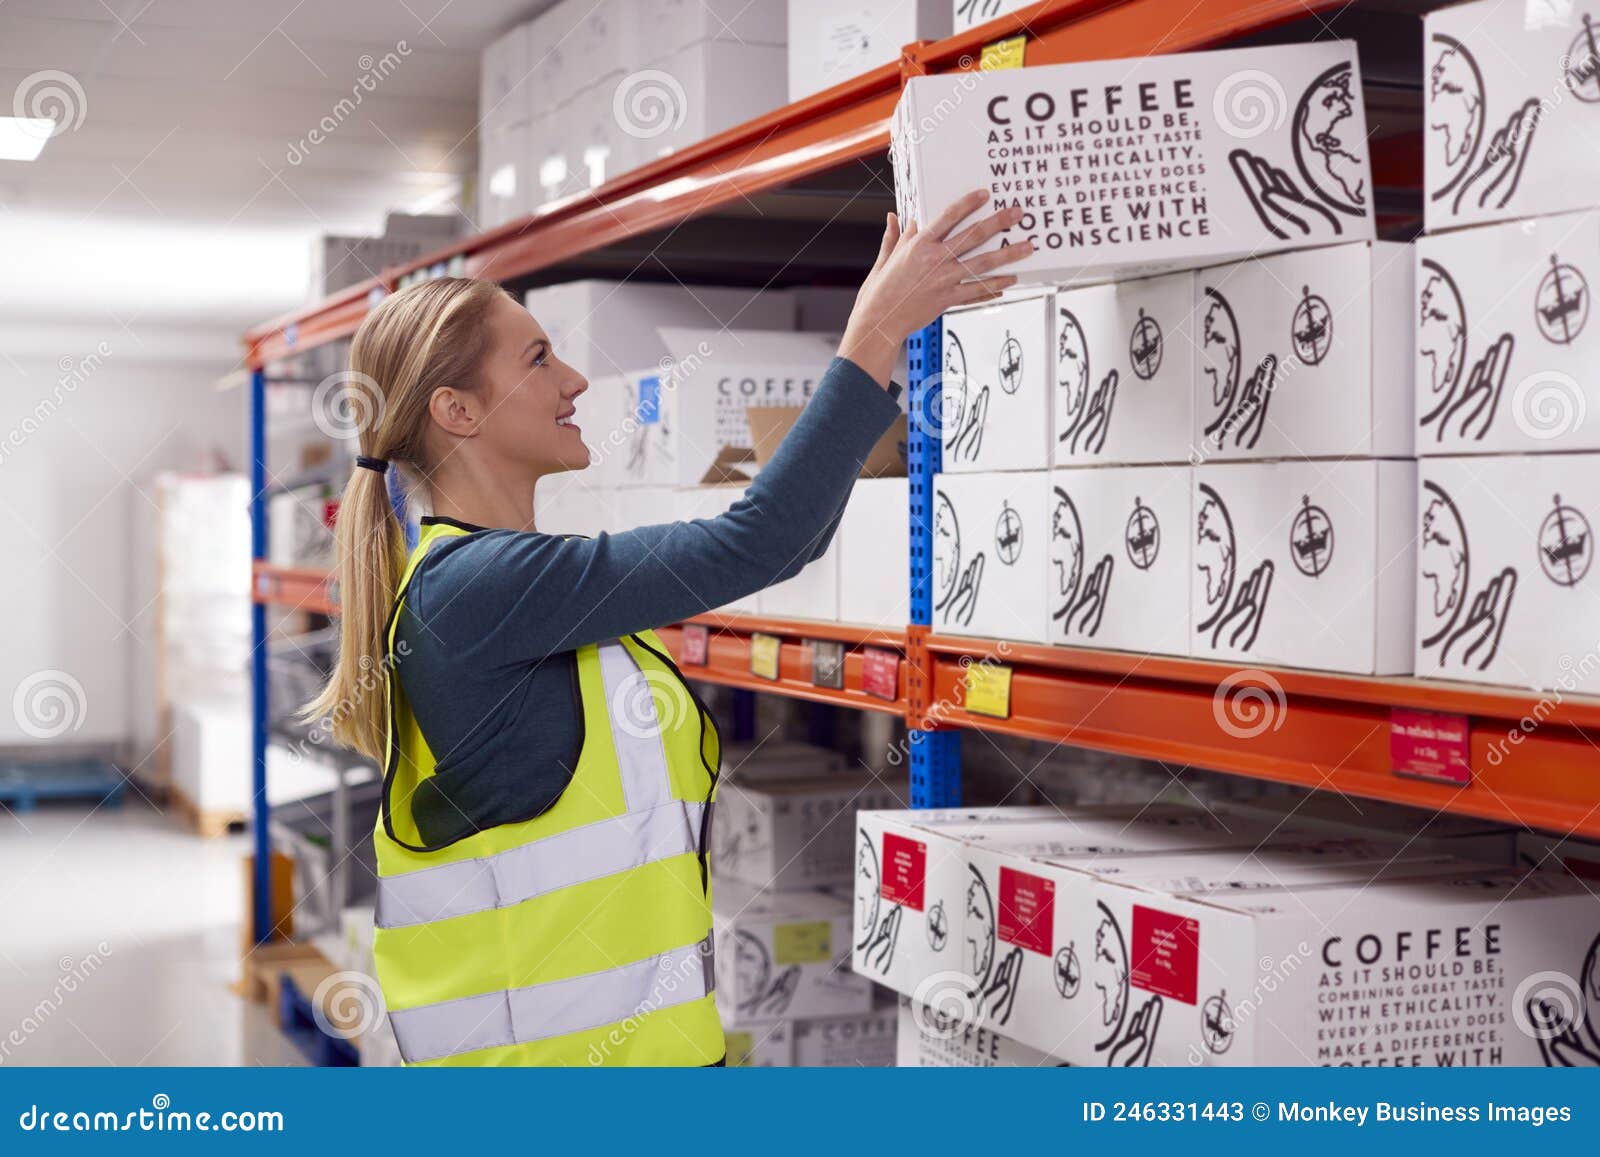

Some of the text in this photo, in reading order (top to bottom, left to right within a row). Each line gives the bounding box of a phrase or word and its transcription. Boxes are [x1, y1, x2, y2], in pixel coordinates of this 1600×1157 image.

[987, 79, 1194, 125] COFFEE
[987, 112, 1199, 144] AS IT SHOULD BE,
[988, 130, 1202, 159] COMBINING GREAT TASTE
[990, 146, 1202, 176] WITH ETHICALITY.
[991, 164, 1206, 193] EVERY SIP REALLY DOES
[994, 181, 1206, 211] MAKE A DIFFERENCE.
[1001, 197, 1208, 232] OFFEE WITH
[717, 377, 815, 397] COFFE
[1322, 925, 1502, 967] COFFEE
[1319, 959, 1504, 987] AS IT SHOULD BE,
[1318, 977, 1505, 1004] COMBINING GREAT TASTE
[1319, 994, 1503, 1023] WITH ETHICALITY.
[1318, 1012, 1505, 1041] EVERY SIP REALLY DOES
[1318, 1030, 1503, 1060] MAKE A DIFFERENCE.
[1435, 1046, 1502, 1067] WITH
